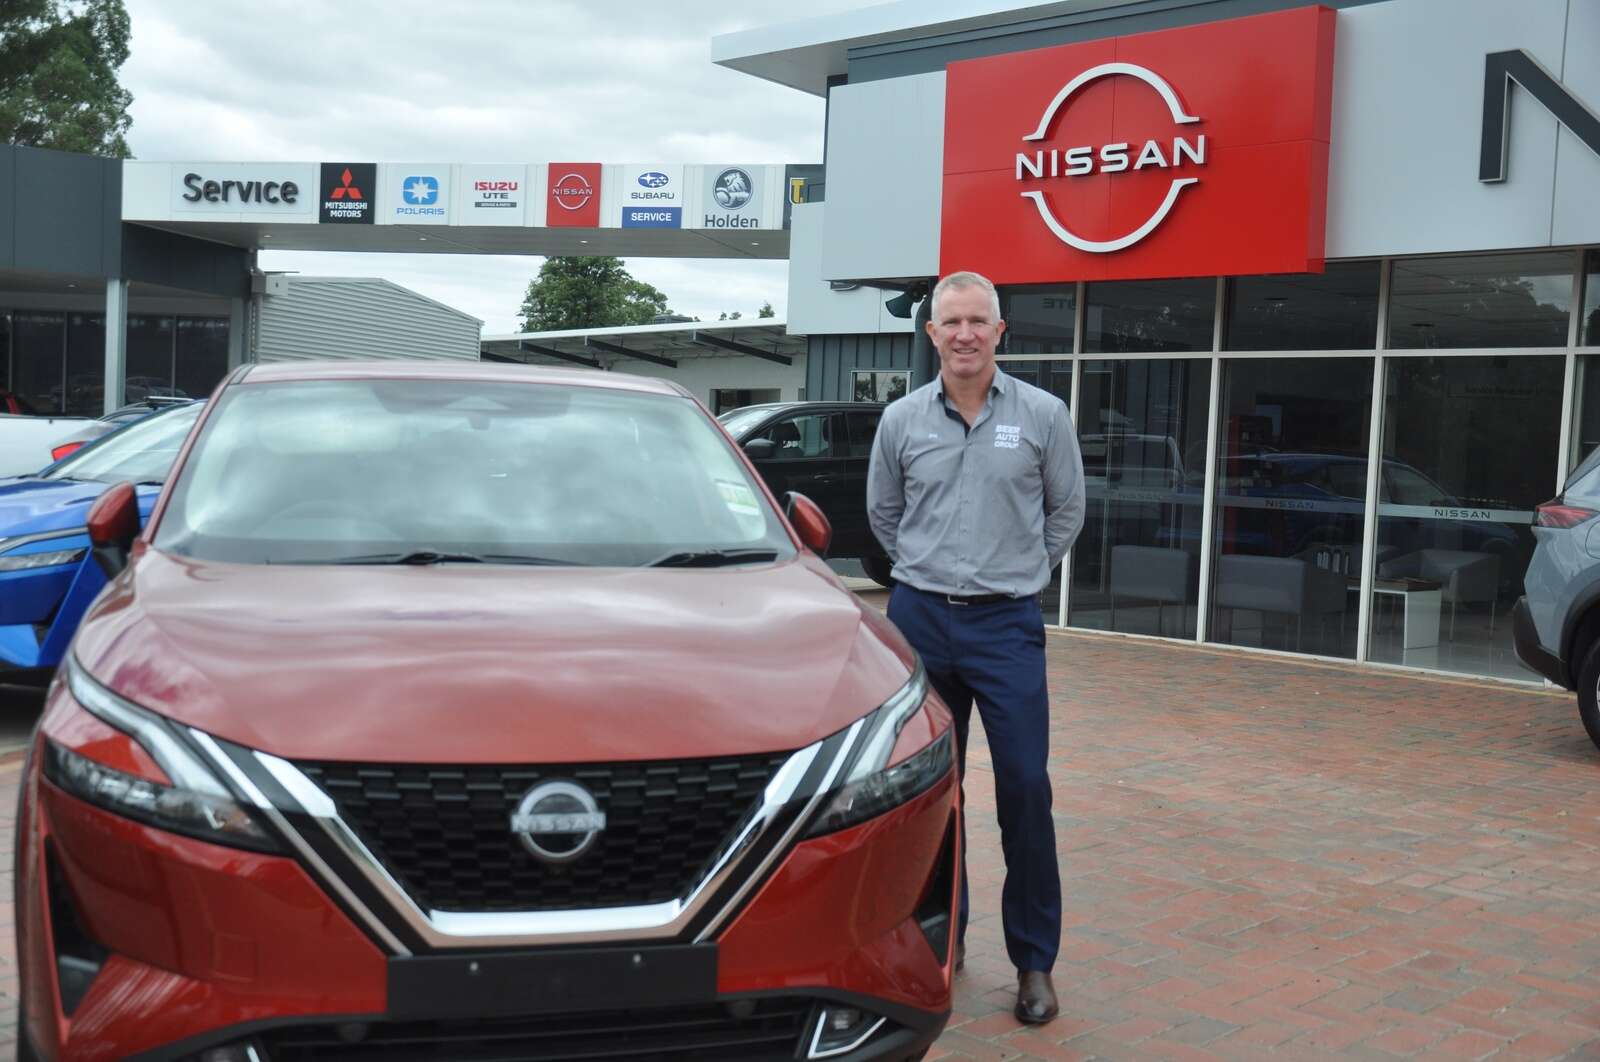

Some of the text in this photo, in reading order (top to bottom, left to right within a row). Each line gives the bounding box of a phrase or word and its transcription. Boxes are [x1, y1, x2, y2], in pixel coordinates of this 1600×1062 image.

[1016, 135, 1205, 180] NISSAN
[182, 172, 299, 204] Service
[475, 181, 518, 191] ISUZU
[552, 187, 593, 196] NISSAN
[631, 192, 675, 200] SUBARU
[325, 202, 367, 211] MITSUBISHI
[396, 207, 445, 216] POLARIS
[330, 209, 362, 218] MOTORS
[631, 211, 672, 222] SERVICE
[704, 214, 759, 228] Holden
[995, 433, 1020, 441] AUTO
[1264, 499, 1315, 509] NISSAN
[1434, 508, 1491, 519] NISSAN
